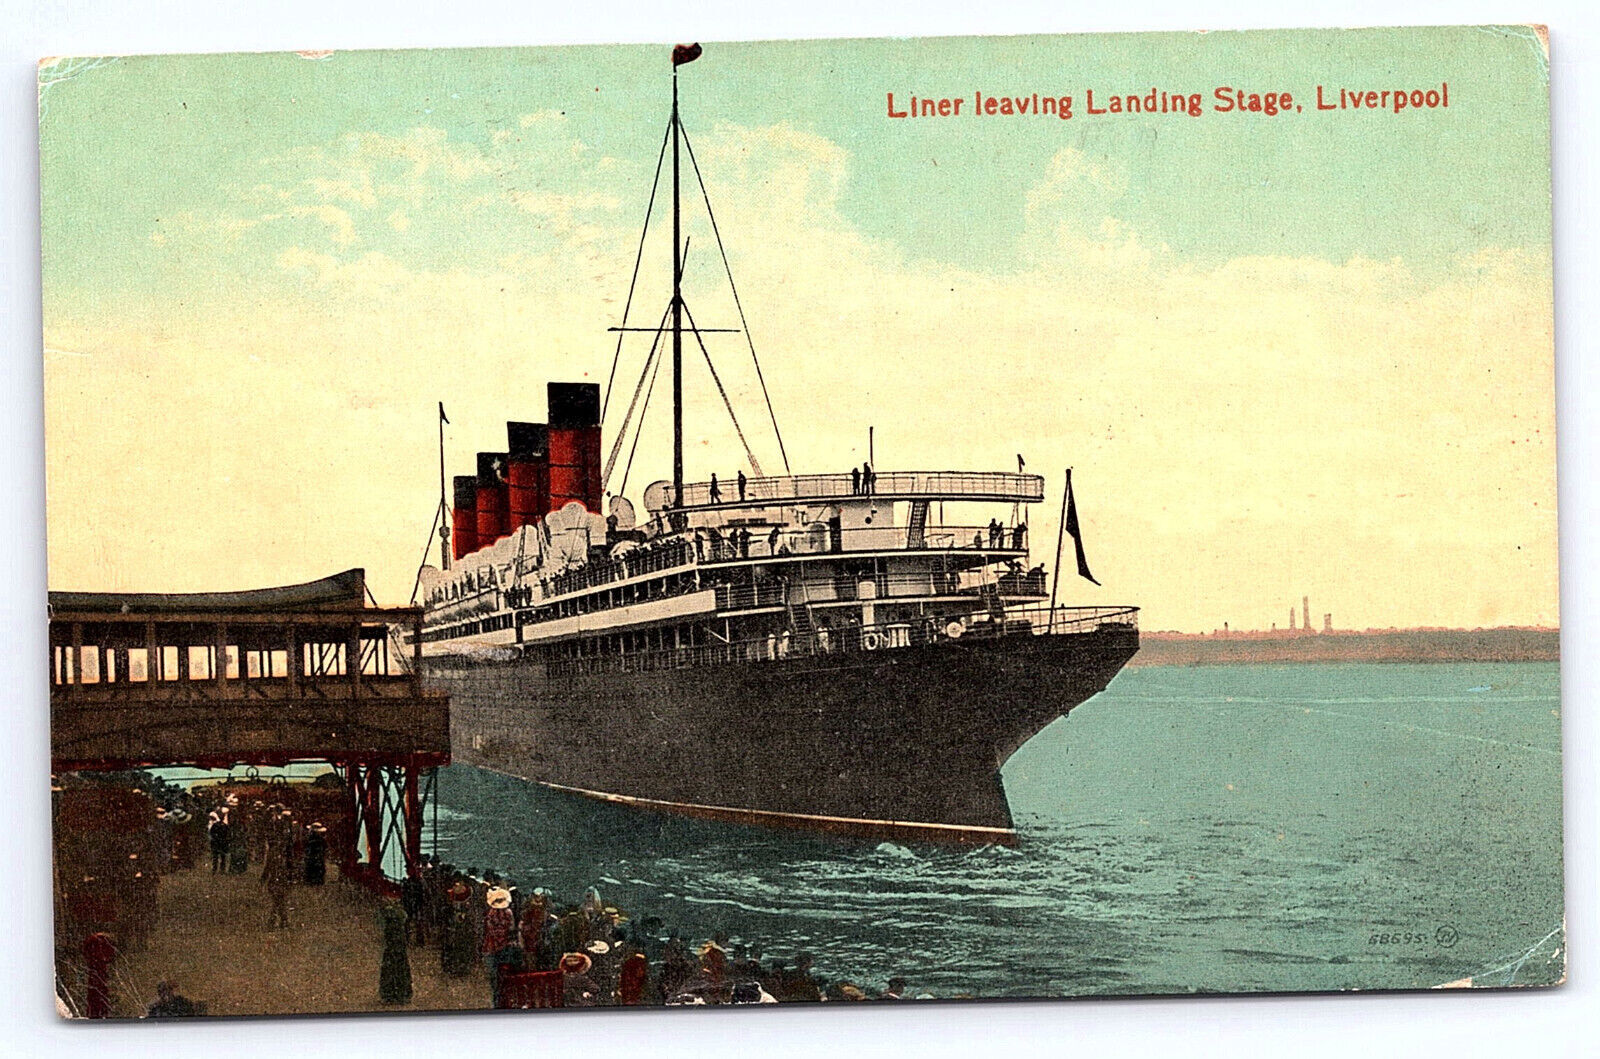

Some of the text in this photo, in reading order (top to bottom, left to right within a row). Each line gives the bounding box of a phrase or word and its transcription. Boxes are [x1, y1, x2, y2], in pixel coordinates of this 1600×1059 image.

[887, 83, 1449, 120] Liner leaving Landing Stage, Liverpool
